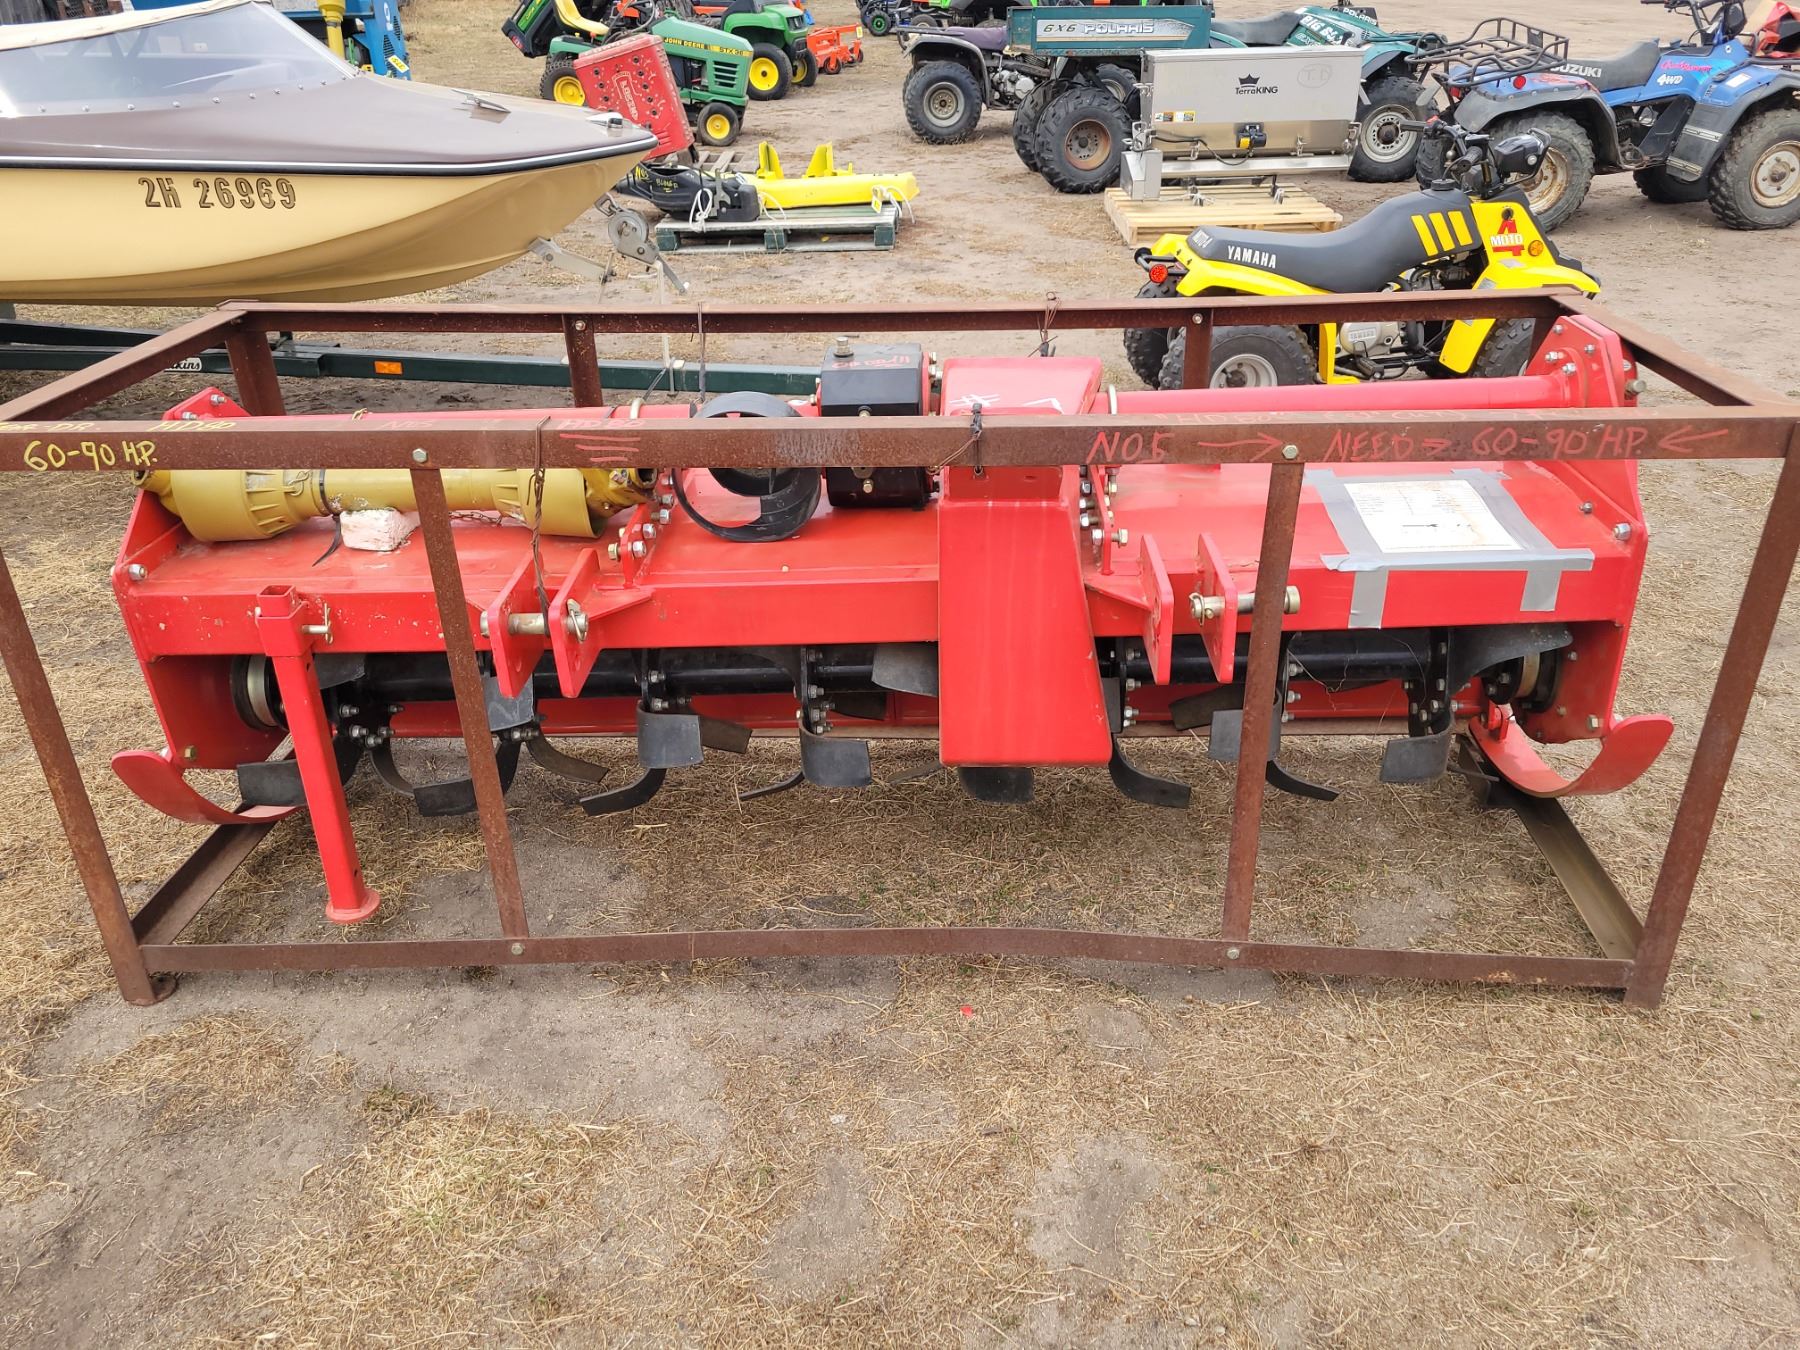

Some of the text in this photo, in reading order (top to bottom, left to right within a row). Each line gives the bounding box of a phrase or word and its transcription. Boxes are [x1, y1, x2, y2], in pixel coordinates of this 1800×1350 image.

[1300, 15, 1325, 31] BIG
[1342, 7, 1377, 26] POLARIS
[1043, 22, 1154, 34] 6X6 POLARIS
[664, 37, 682, 45] JOHN
[683, 40, 705, 49] DEERE
[1551, 64, 1602, 78] SUZUKI
[1657, 74, 1683, 86] 4WD
[1235, 86, 1278, 95] TerraKING
[138, 177, 296, 210] 2H 26969
[1490, 233, 1523, 246] MOTO
[1227, 245, 1277, 269] YAMAHA
[1322, 429, 1413, 461] NEED
[1472, 427, 1588, 459] 60-90
[23, 440, 116, 471] 60-90
